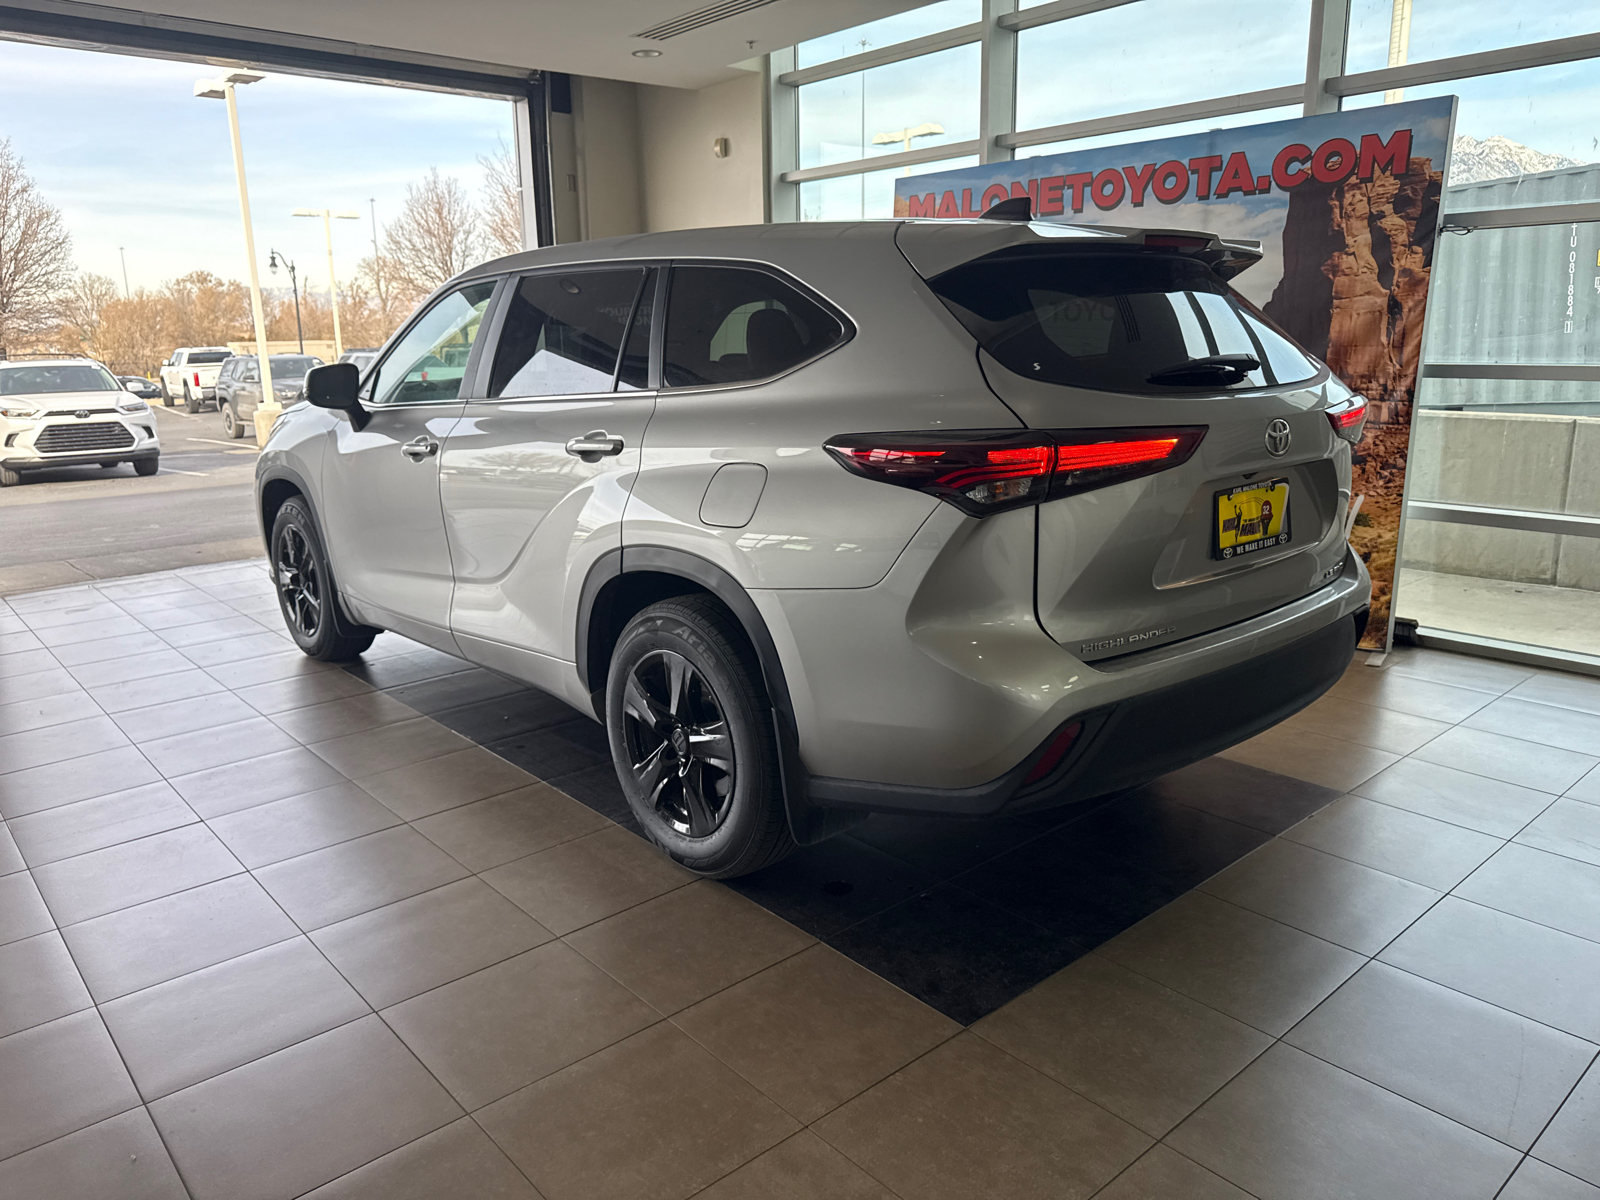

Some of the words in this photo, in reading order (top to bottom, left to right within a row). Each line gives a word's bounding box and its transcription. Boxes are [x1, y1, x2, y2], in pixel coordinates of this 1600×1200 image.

[909, 128, 1413, 219] MALONETOYOTA.COM
[1566, 251, 1576, 317] 081884
[1262, 505, 1270, 514] 32
[1236, 545, 1245, 554] WE
[1245, 542, 1258, 552] MAKE
[1258, 540, 1264, 549] IT
[1264, 537, 1276, 547] EASY
[672, 626, 717, 668] Aria
[1081, 626, 1176, 653] HIGHLANDER
